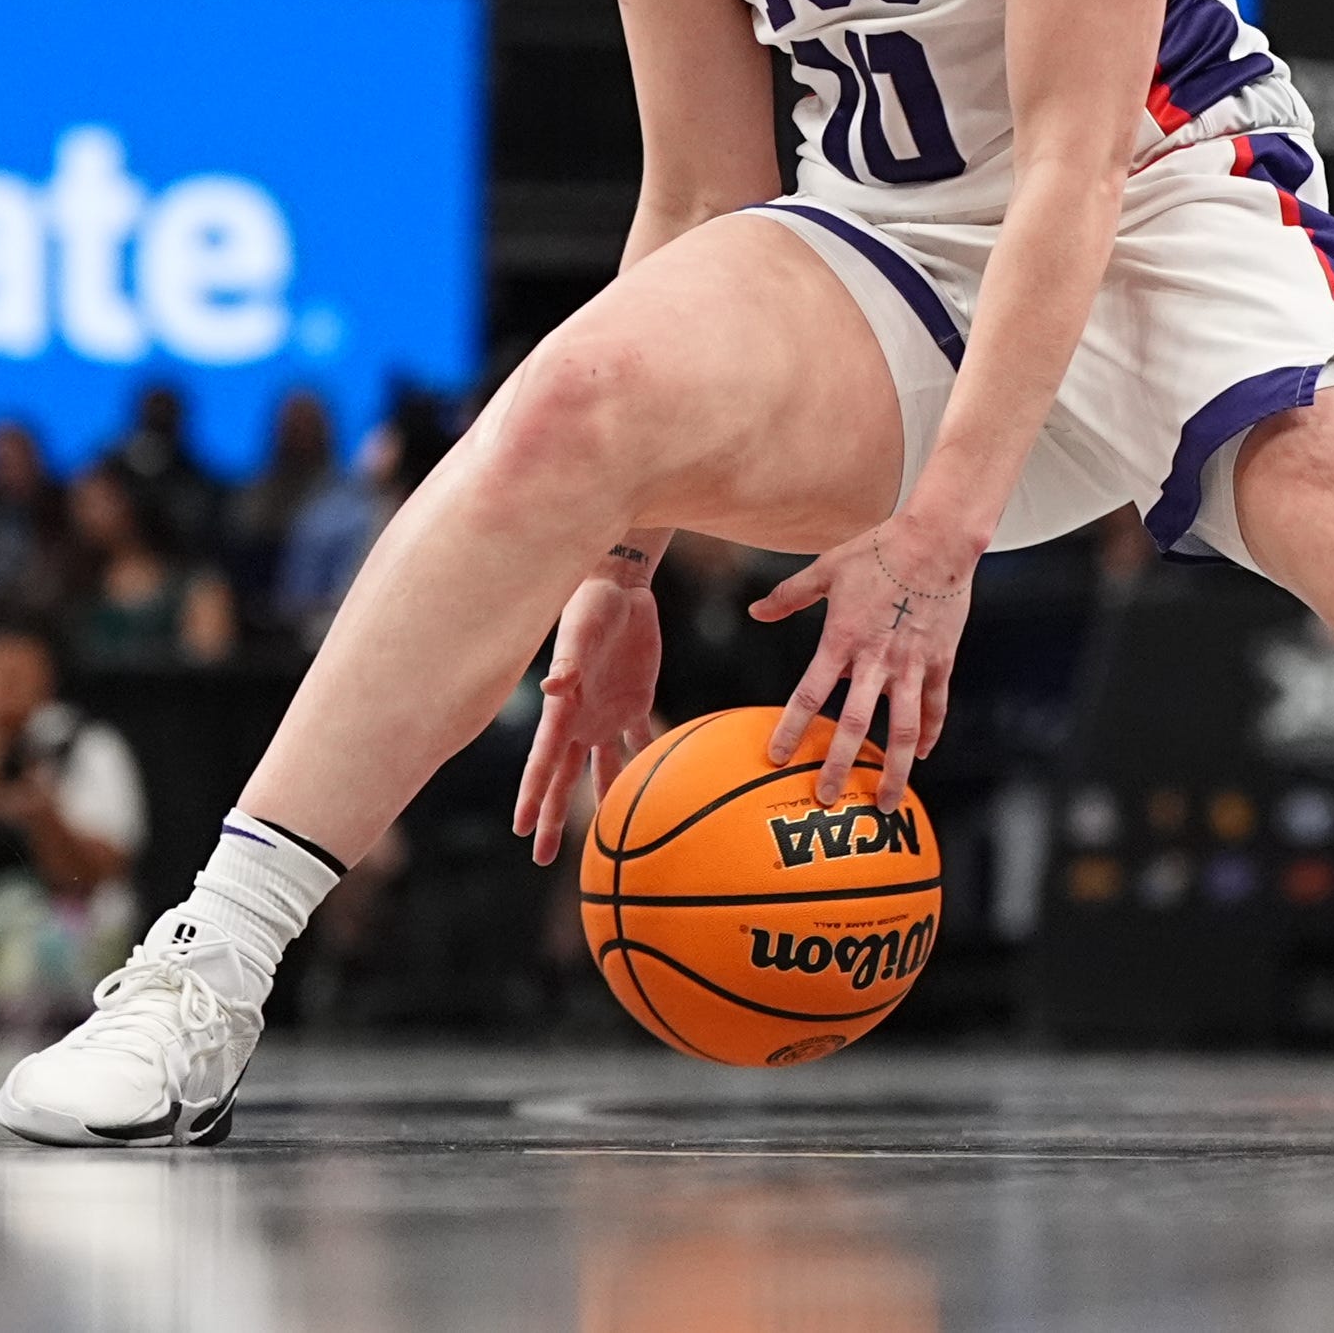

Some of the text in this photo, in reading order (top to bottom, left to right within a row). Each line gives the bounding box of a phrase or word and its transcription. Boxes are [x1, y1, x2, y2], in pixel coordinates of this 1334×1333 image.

[792, 29, 968, 185] 10
[768, 805, 920, 869] NCAA
[750, 913, 935, 991] Wilson
